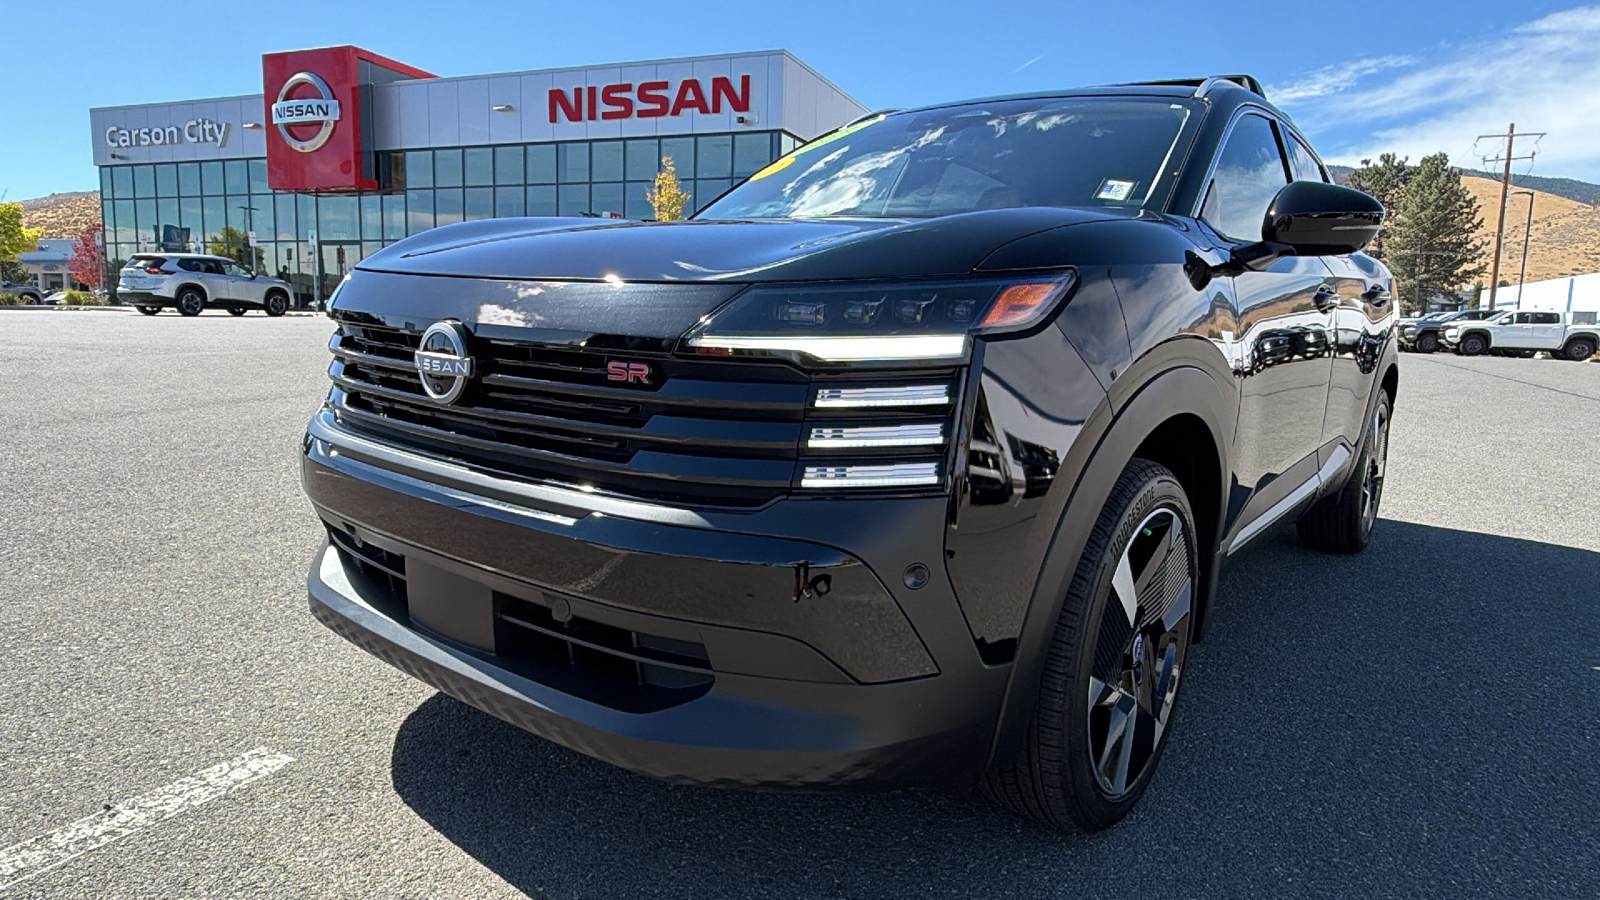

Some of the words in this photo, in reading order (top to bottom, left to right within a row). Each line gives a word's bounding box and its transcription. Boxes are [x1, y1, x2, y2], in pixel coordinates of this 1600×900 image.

[275, 103, 329, 119] NISSAN
[548, 74, 750, 123] NISSAN
[106, 126, 178, 147] Carson
[184, 117, 227, 147] City
[415, 354, 468, 374] NSSAN
[607, 361, 650, 384] SR
[1109, 486, 1155, 559] BRIDGESTONE
